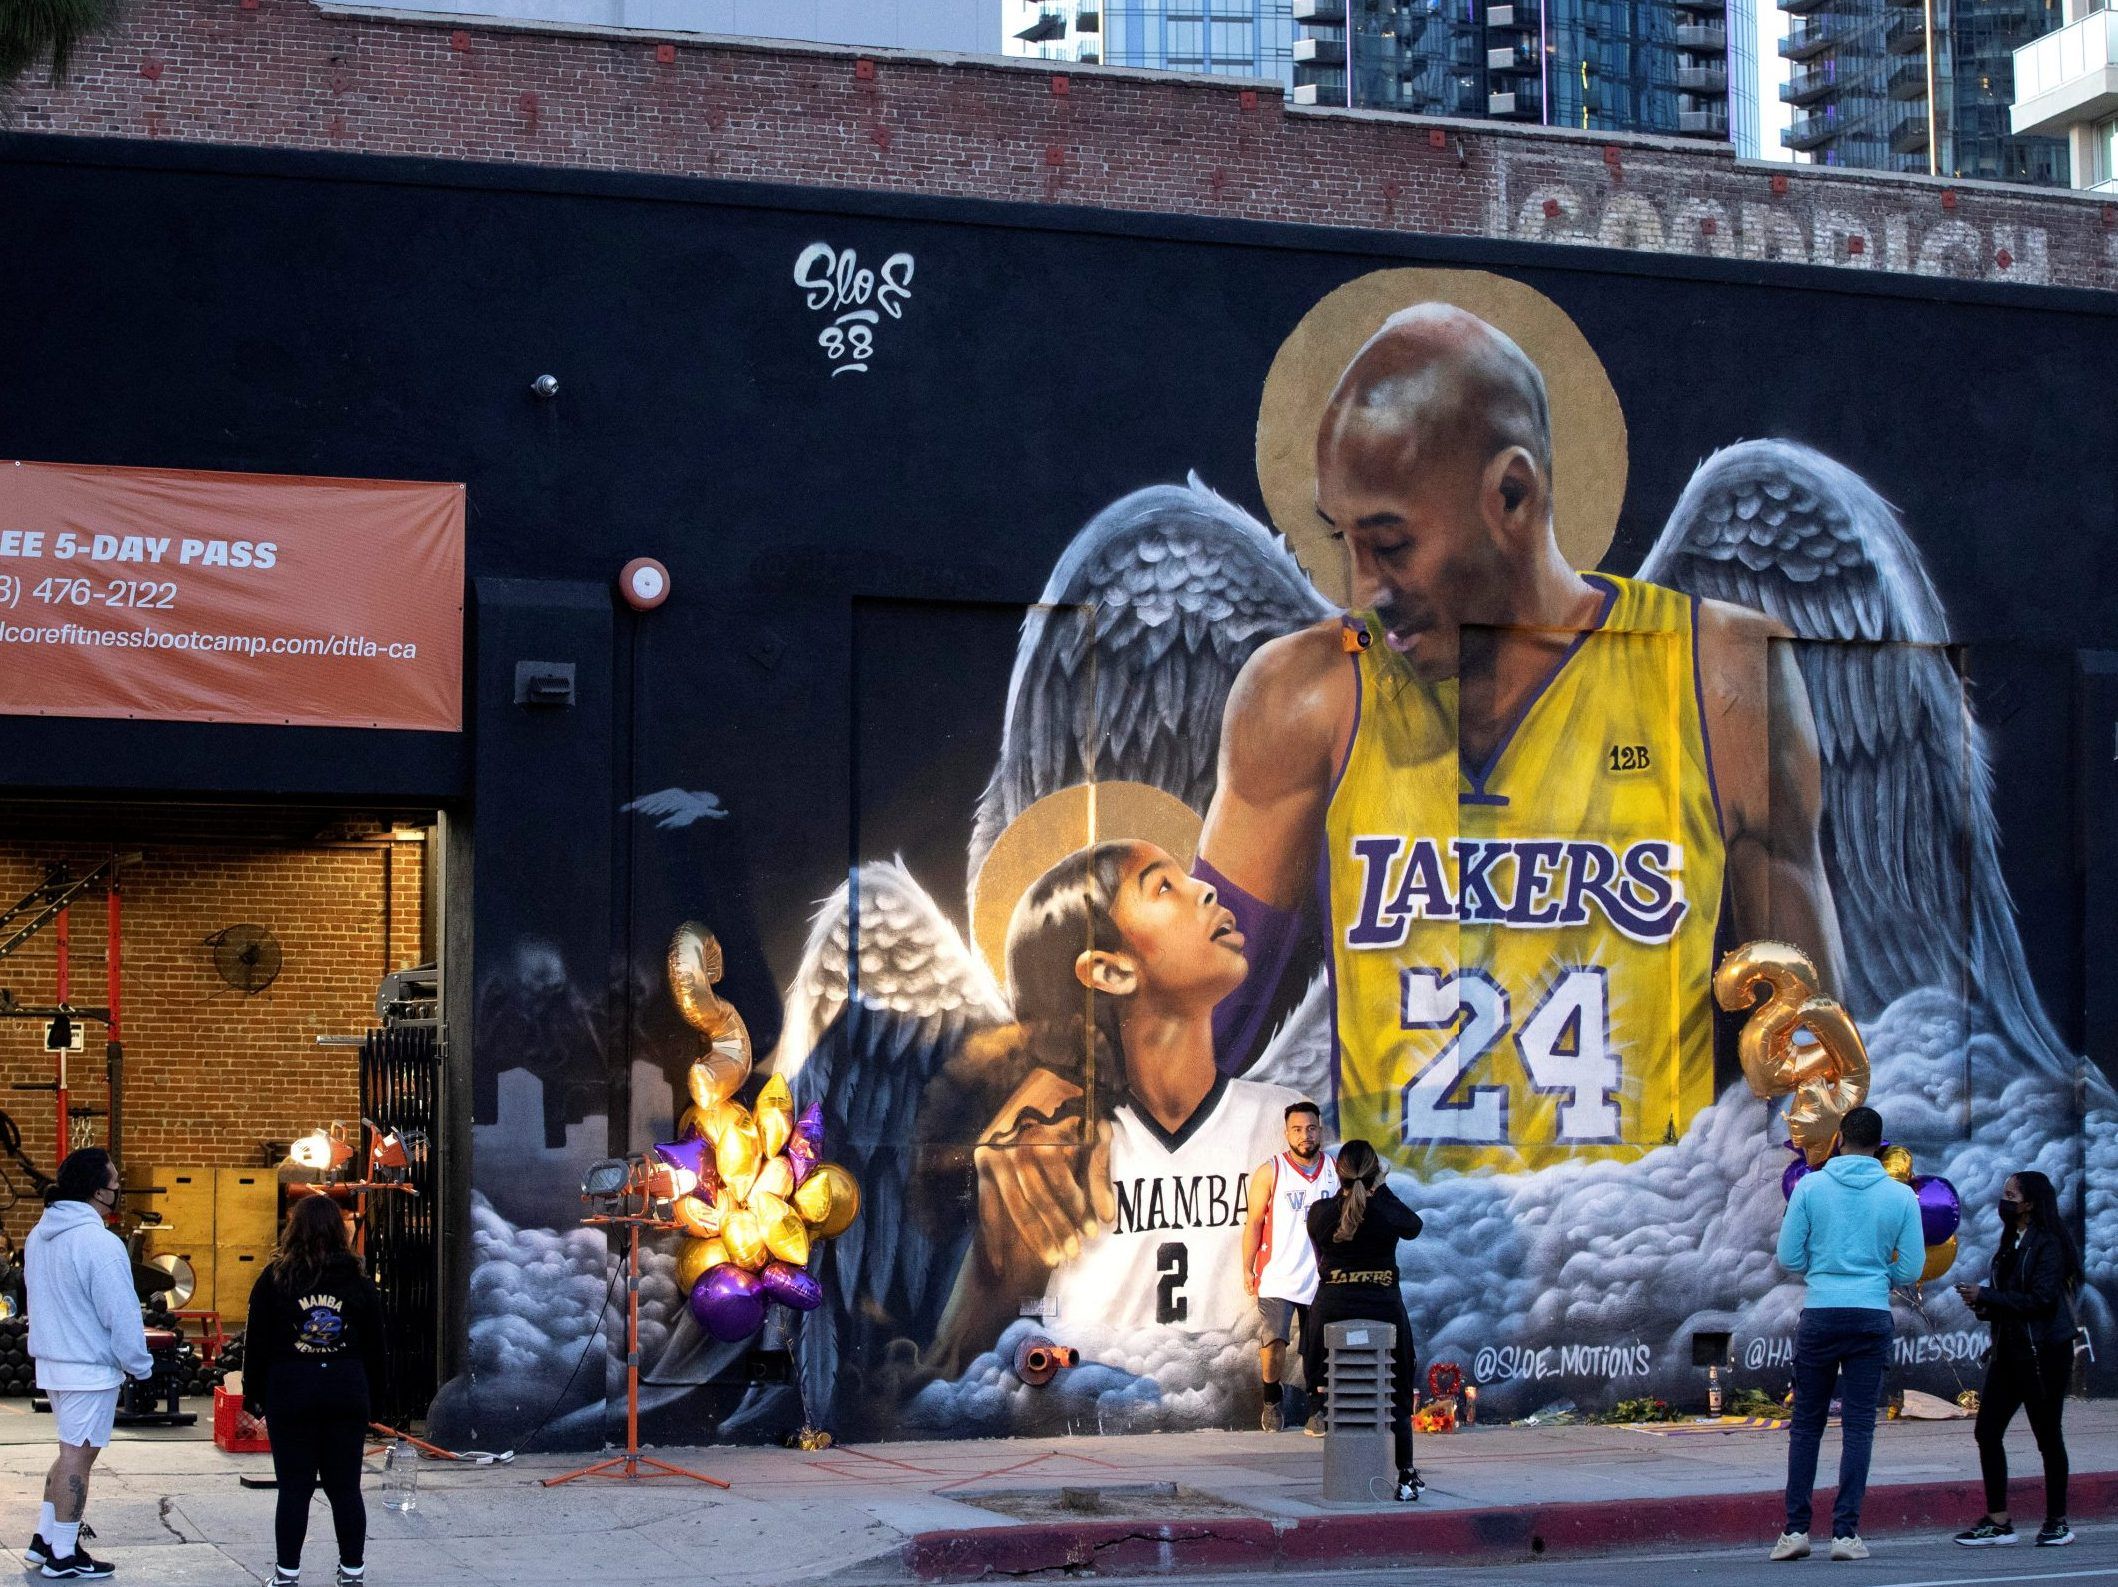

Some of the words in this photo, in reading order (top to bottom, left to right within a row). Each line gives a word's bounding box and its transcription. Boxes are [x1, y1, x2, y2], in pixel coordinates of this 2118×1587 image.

[818, 325, 874, 359] 88
[54, 533, 170, 564] 5-DAY
[179, 538, 278, 569] PASS
[32, 577, 178, 609] 476-2122
[1609, 745, 1651, 771] 12B
[1346, 834, 1691, 949] LAKERS
[1401, 965, 1623, 1146] 24
[1113, 1172, 1250, 1235] MAMBA
[1156, 1242, 1189, 1325] 2
[1326, 1269, 1394, 1287] LAKERS
[297, 1294, 343, 1313] MAMBA
[293, 1340, 347, 1354] MENTAL
